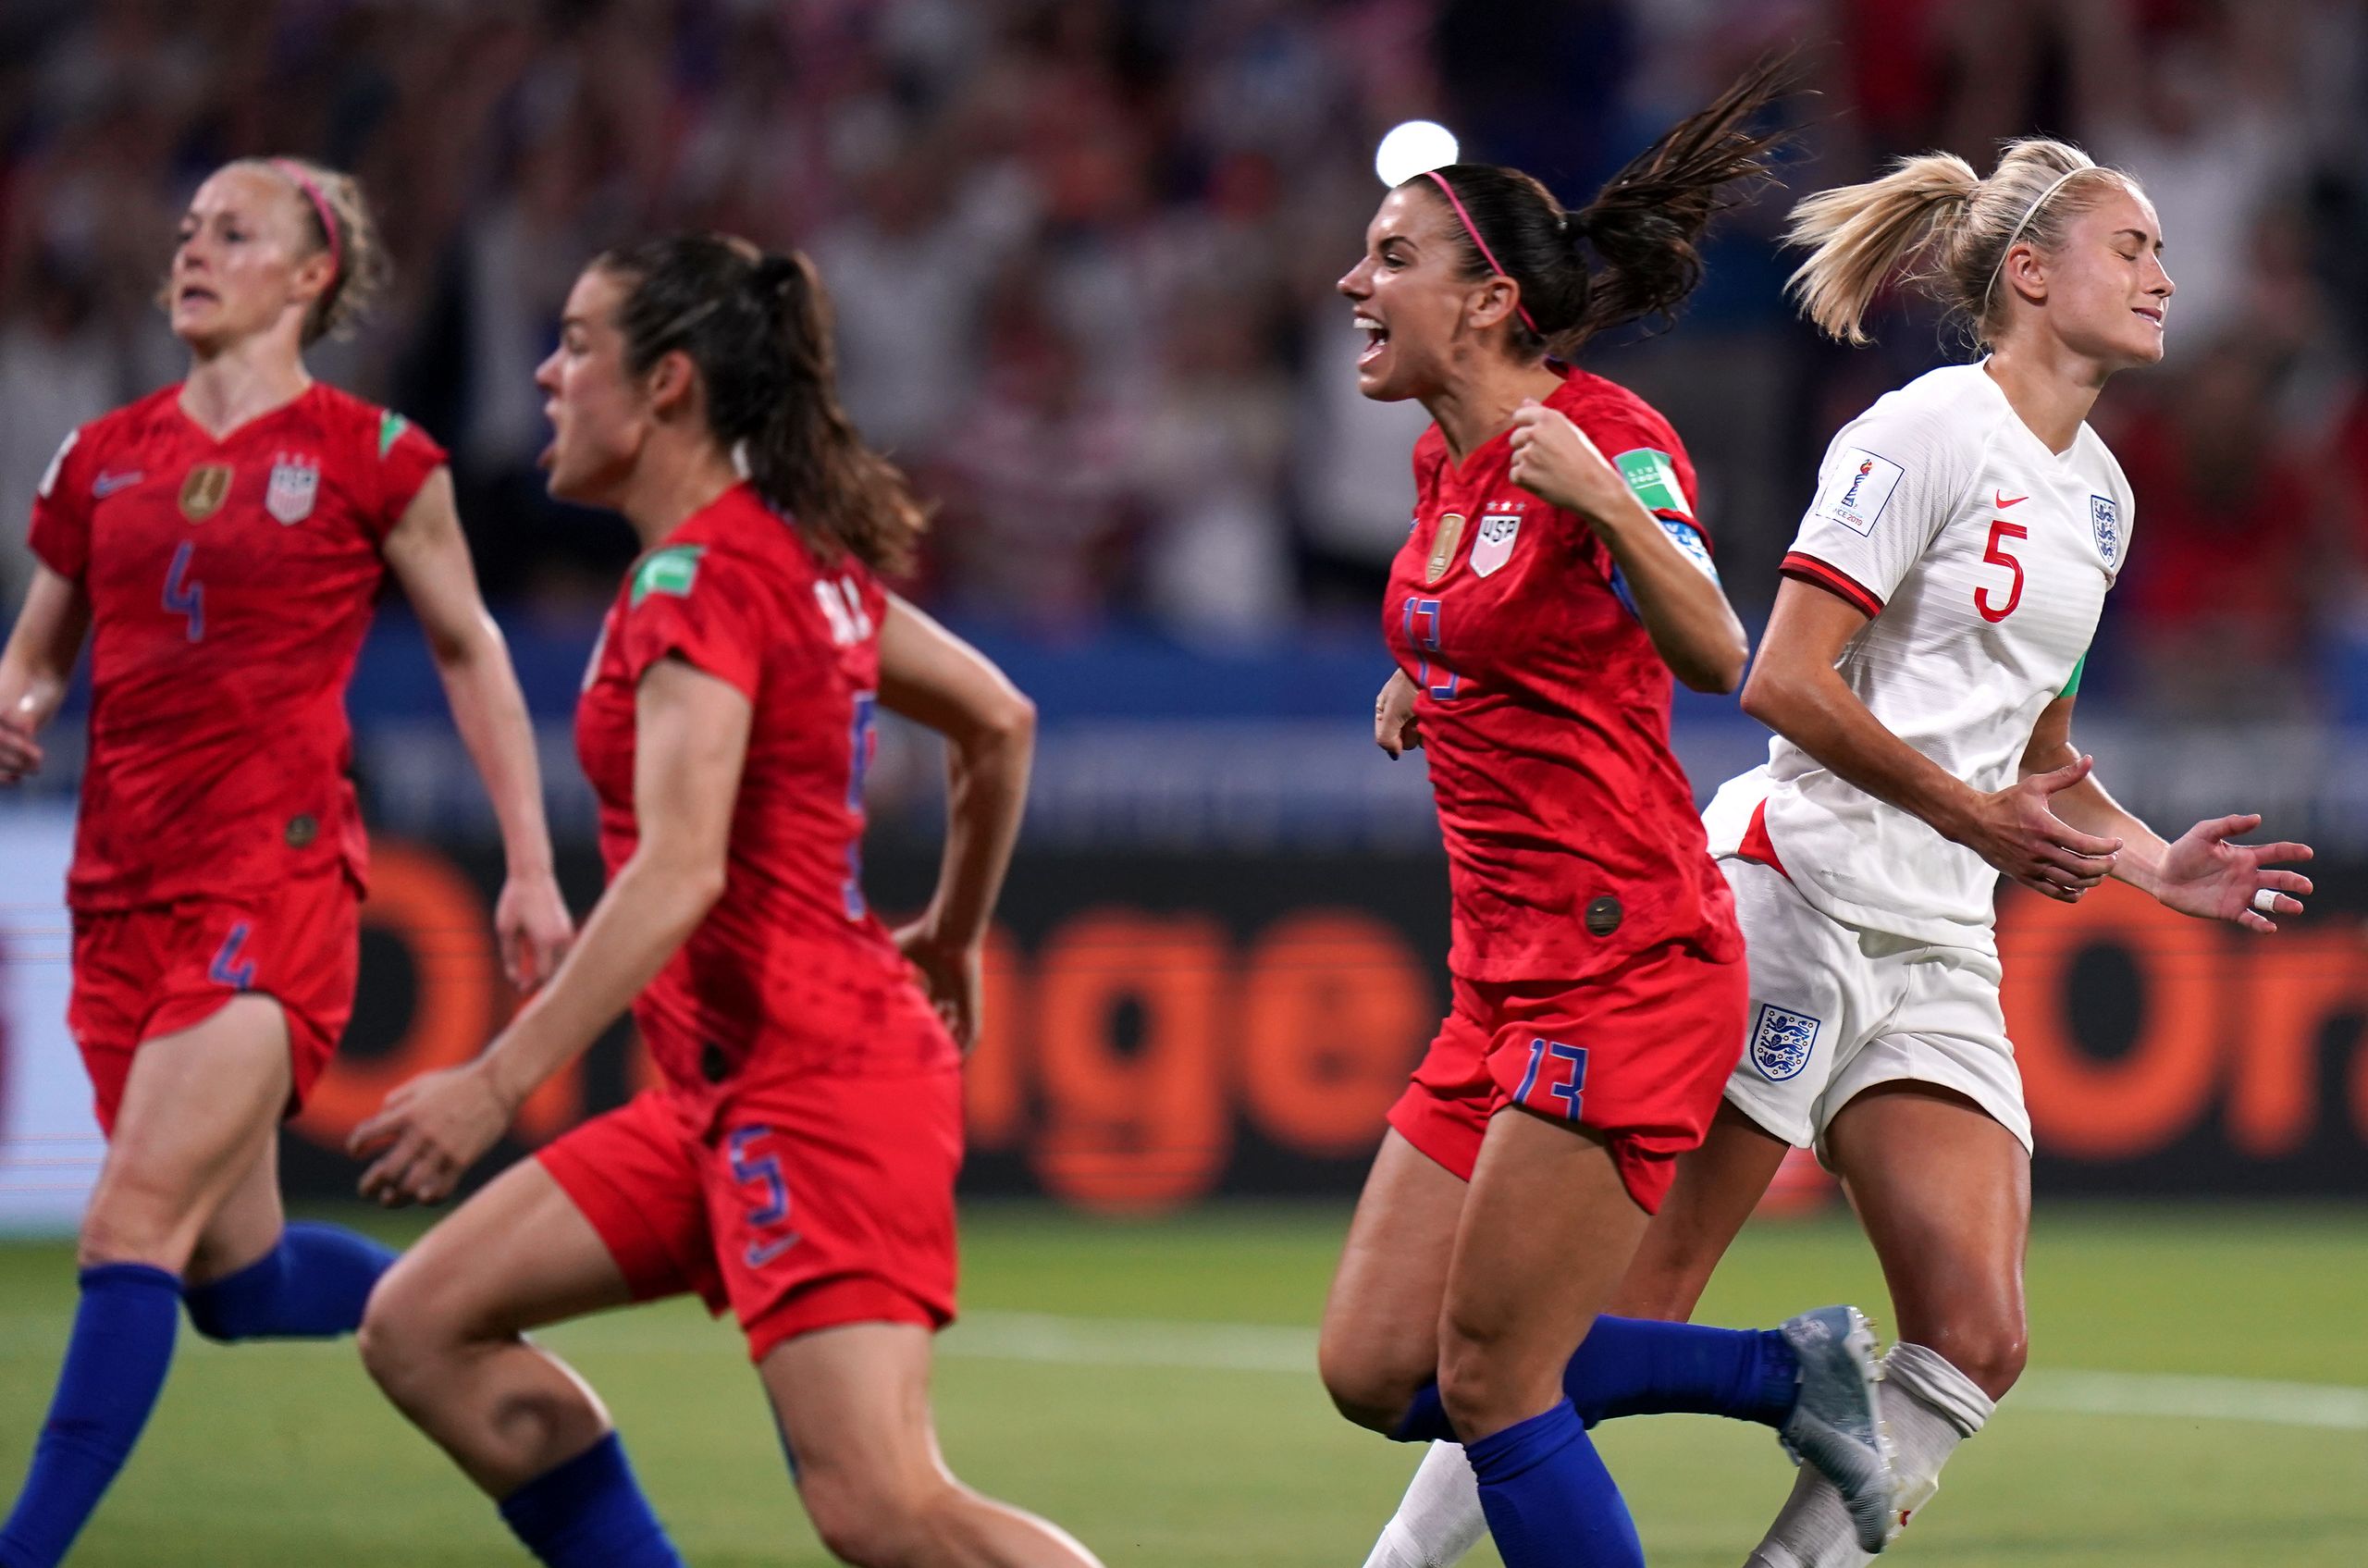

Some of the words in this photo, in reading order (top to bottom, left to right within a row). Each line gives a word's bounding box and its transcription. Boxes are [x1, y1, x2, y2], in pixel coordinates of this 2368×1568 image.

[1482, 519, 1518, 542] USA
[1846, 514, 1863, 526] 2019
[163, 540, 204, 642] 4
[1974, 520, 2028, 623] 5
[1403, 597, 1460, 701] 13
[209, 923, 253, 989] 4
[1998, 851, 2368, 1162] Or
[1513, 1037, 1589, 1123] 13
[728, 1123, 789, 1227] 5
